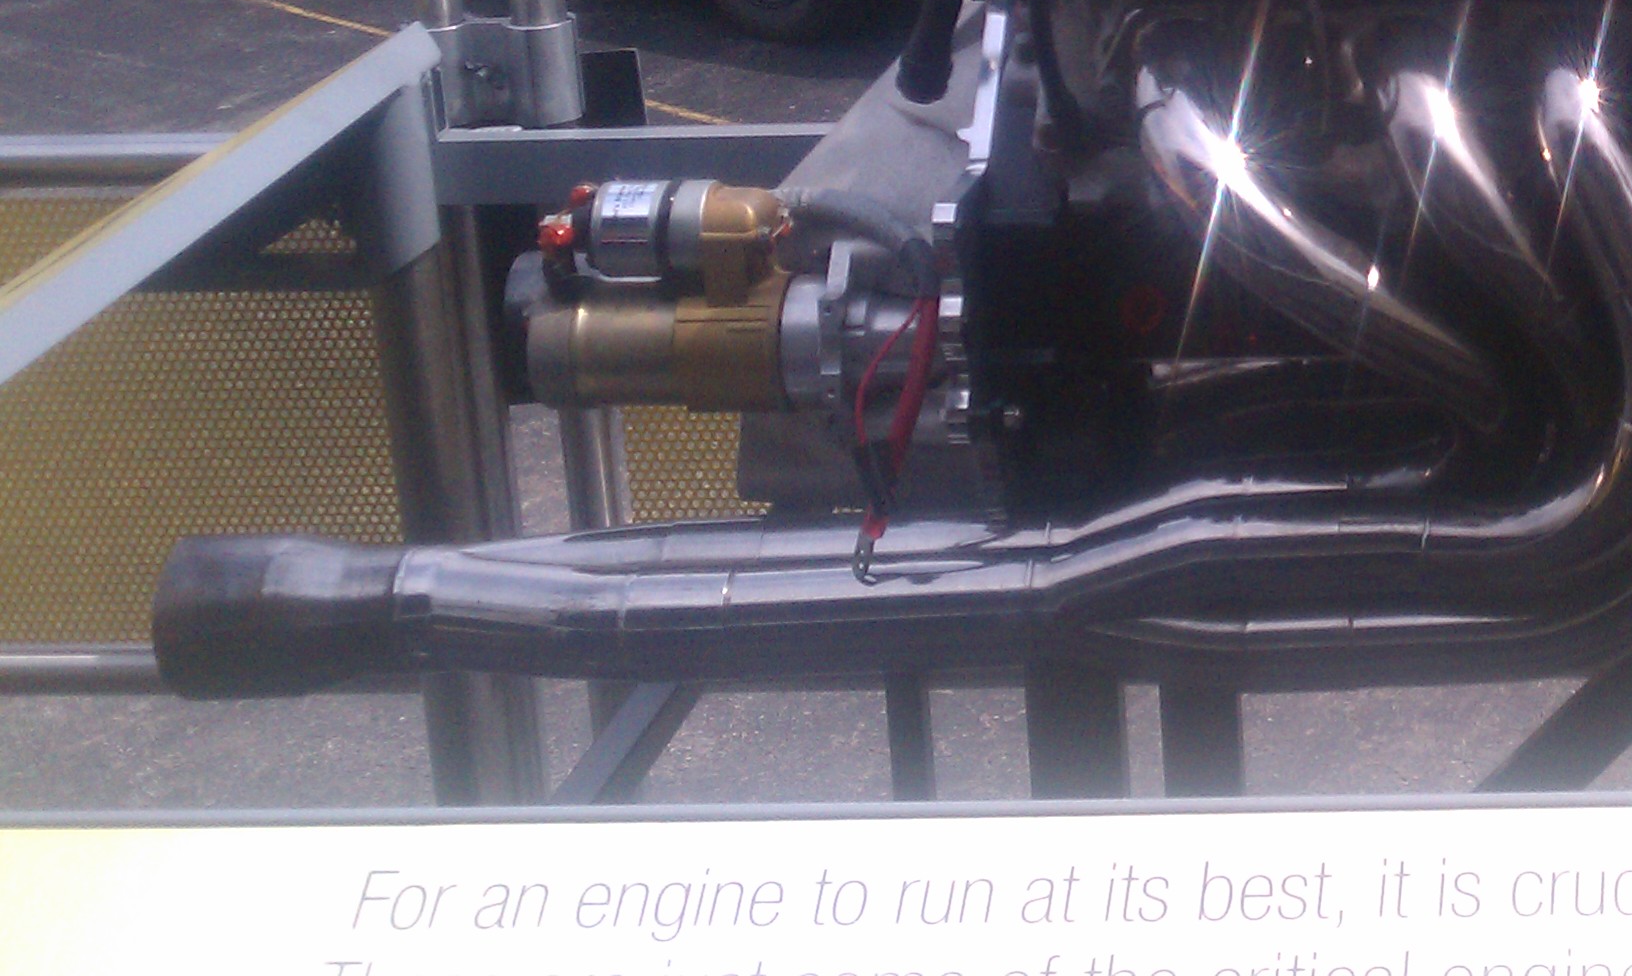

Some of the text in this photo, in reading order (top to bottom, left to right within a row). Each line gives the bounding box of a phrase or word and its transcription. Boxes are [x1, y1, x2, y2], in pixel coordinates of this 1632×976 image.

[352, 870, 446, 930] For
[474, 883, 546, 929] an
[576, 868, 784, 942] engine
[814, 869, 868, 927] to
[896, 879, 994, 925] run
[1021, 866, 1081, 924] at
[1105, 863, 1171, 923] its
[1198, 860, 1345, 927] best,
[1379, 858, 1412, 918] it
[1439, 858, 1482, 918] is
